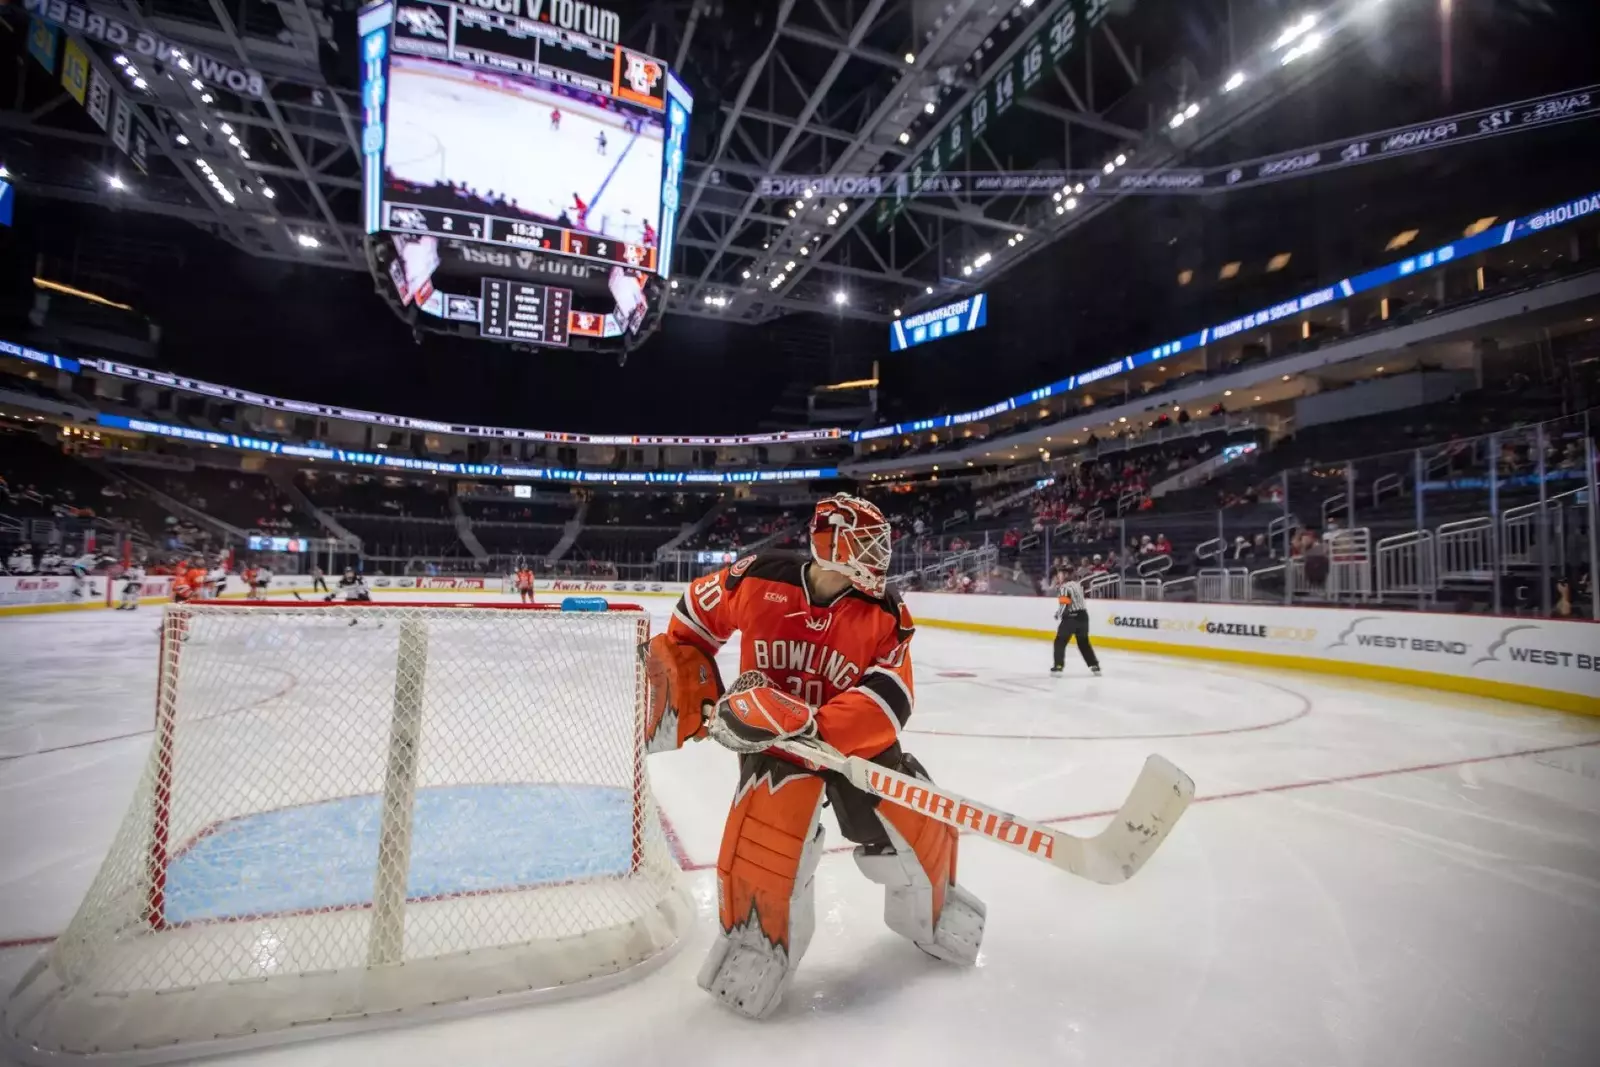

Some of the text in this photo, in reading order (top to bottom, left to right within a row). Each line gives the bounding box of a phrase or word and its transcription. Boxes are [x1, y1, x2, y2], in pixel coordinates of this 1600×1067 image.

[1050, 11, 1076, 54] 32
[1022, 45, 1042, 82] 16
[996, 71, 1014, 108] 14
[971, 97, 987, 132] 10
[951, 124, 961, 150] 8
[442, 216, 453, 231] 2
[597, 242, 608, 256] 2
[693, 573, 723, 612] 30
[1113, 615, 1159, 630] GAZELLE
[1206, 621, 1268, 638] GAZELLE
[1357, 634, 1467, 656] WEST BEND
[1509, 646, 1573, 667] WEST
[754, 640, 860, 691] BOWLING
[786, 675, 823, 709] 30
[870, 769, 1056, 860] WARRIOR
